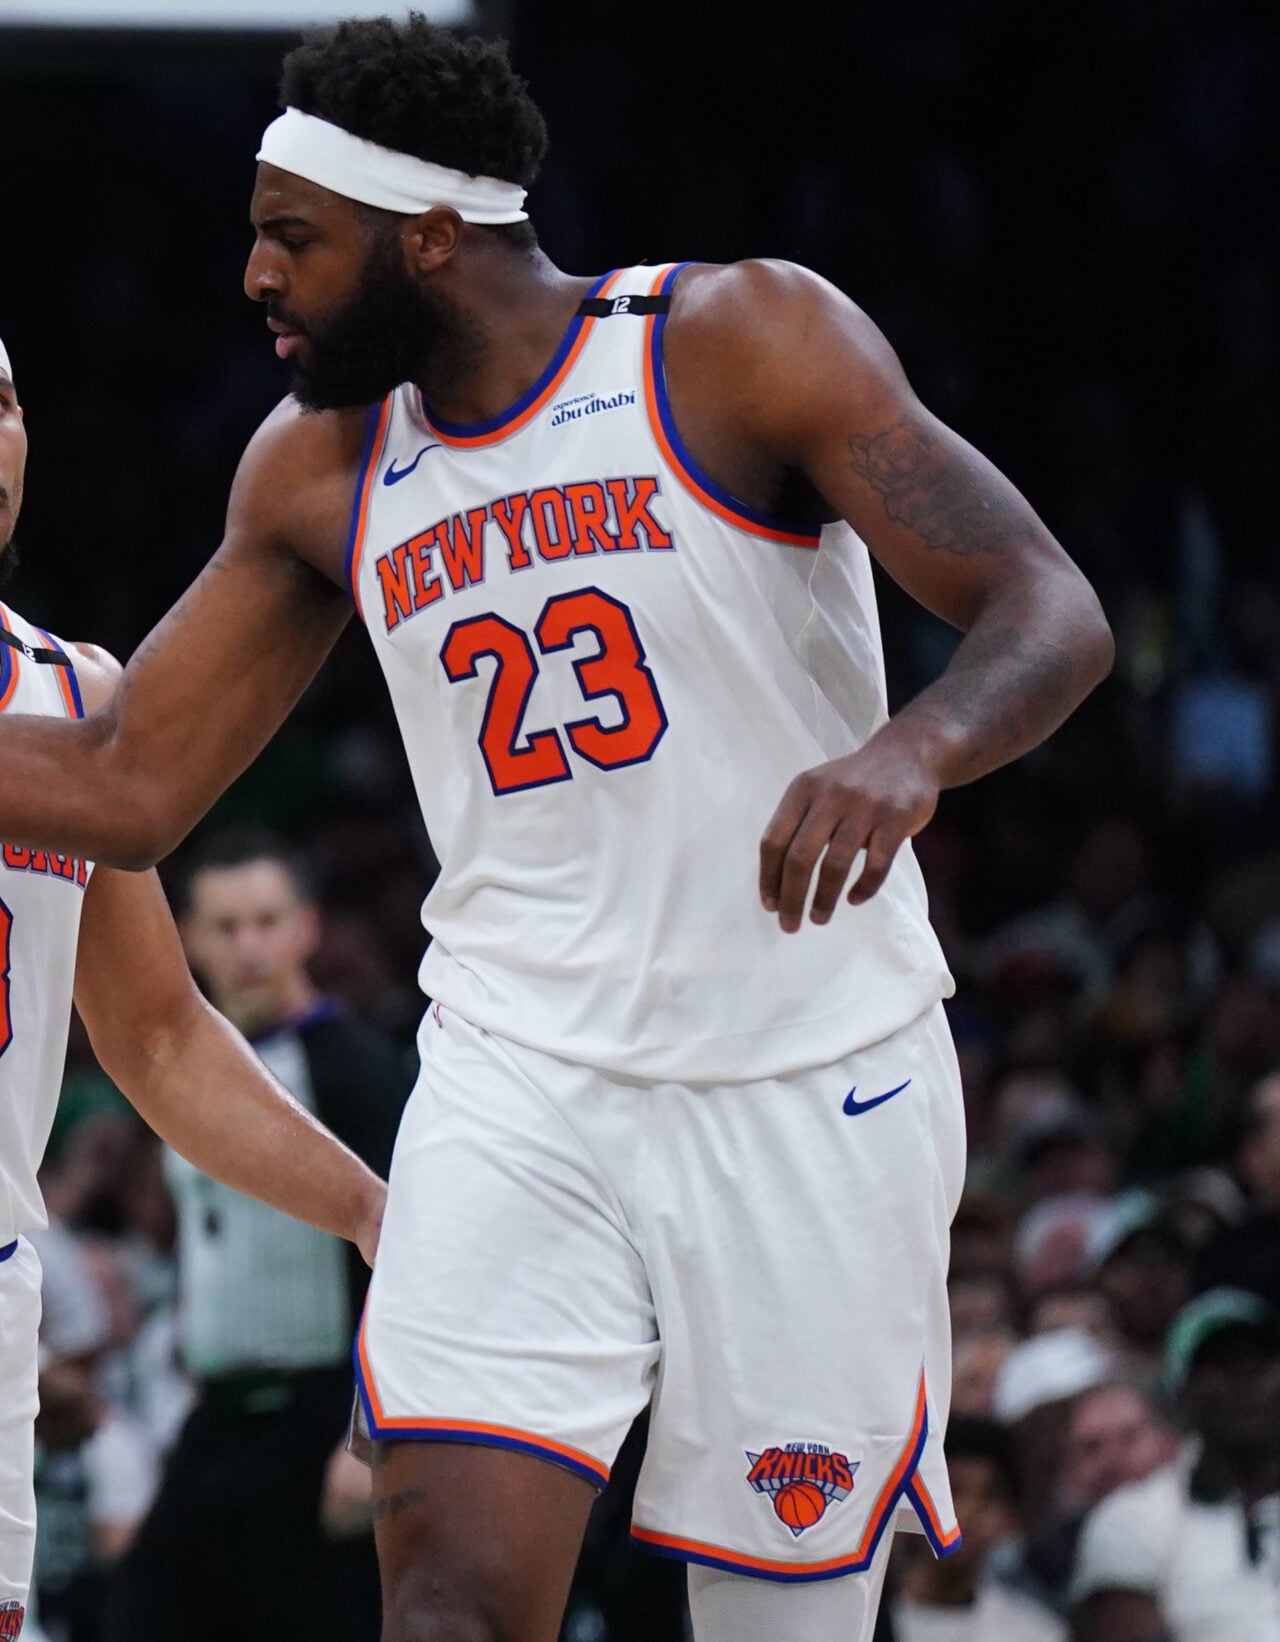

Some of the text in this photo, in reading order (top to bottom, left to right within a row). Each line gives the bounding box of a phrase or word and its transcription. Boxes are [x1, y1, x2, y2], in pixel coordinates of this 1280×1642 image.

[611, 296, 631, 314] 12
[551, 390, 636, 427] abu dhabi
[375, 474, 677, 636] NEW YORK
[439, 586, 669, 797] 23
[746, 1446, 854, 1493] KNICKS
